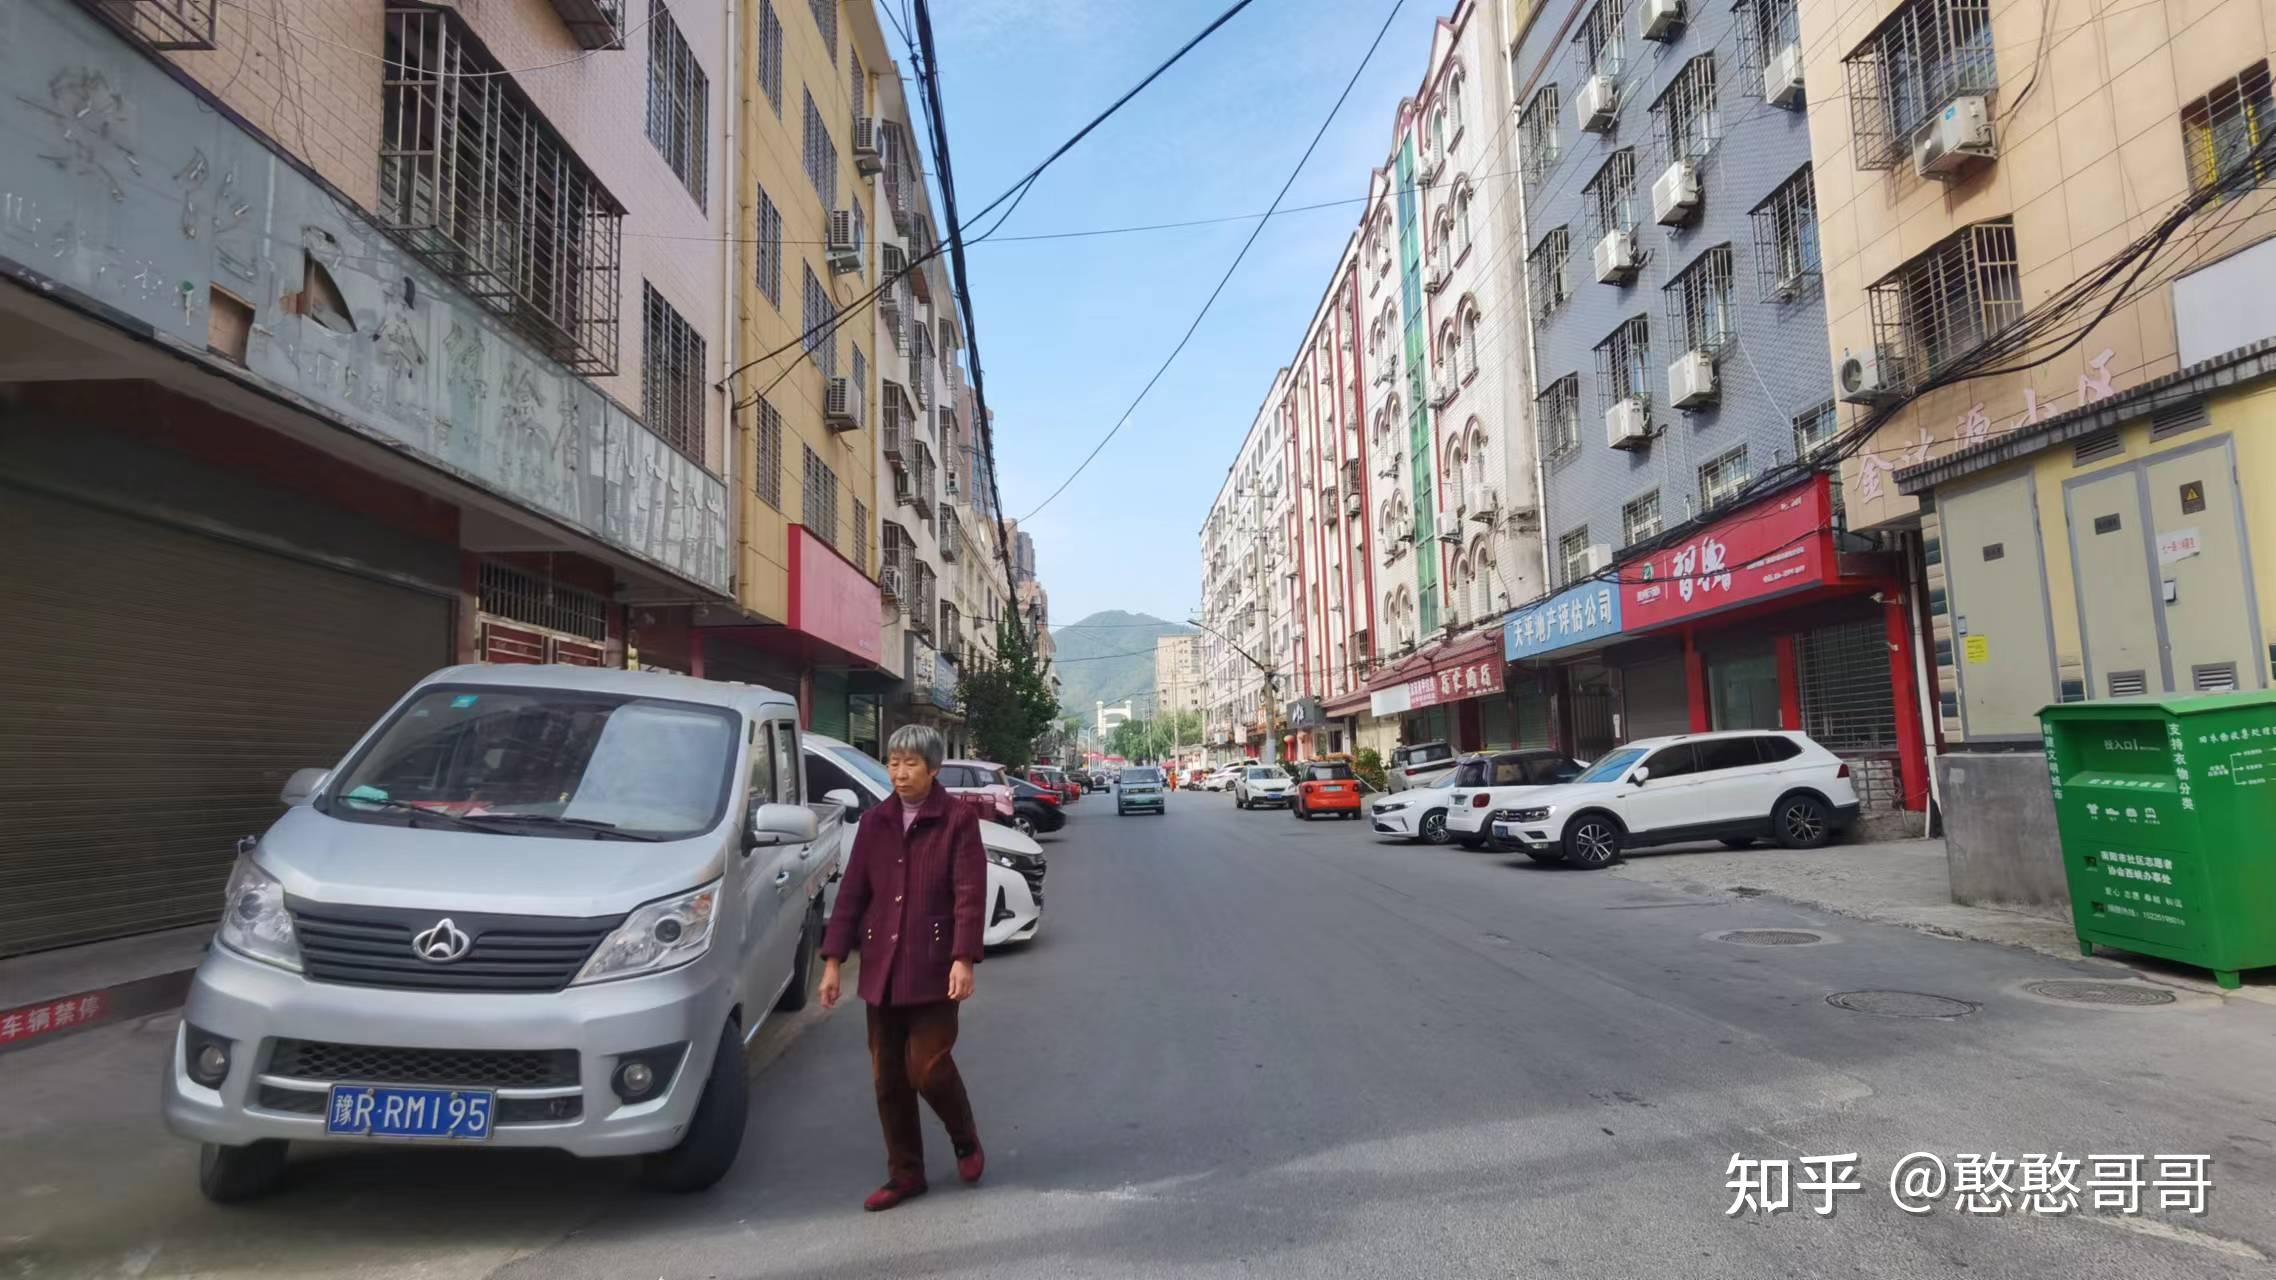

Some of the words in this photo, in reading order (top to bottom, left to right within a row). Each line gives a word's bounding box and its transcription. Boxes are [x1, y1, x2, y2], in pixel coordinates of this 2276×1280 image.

[1513, 587, 1613, 649] 天平地产评估公司
[2168, 722, 2195, 811] 支持衣物分类
[0, 994, 100, 1039] 车辆禁停
